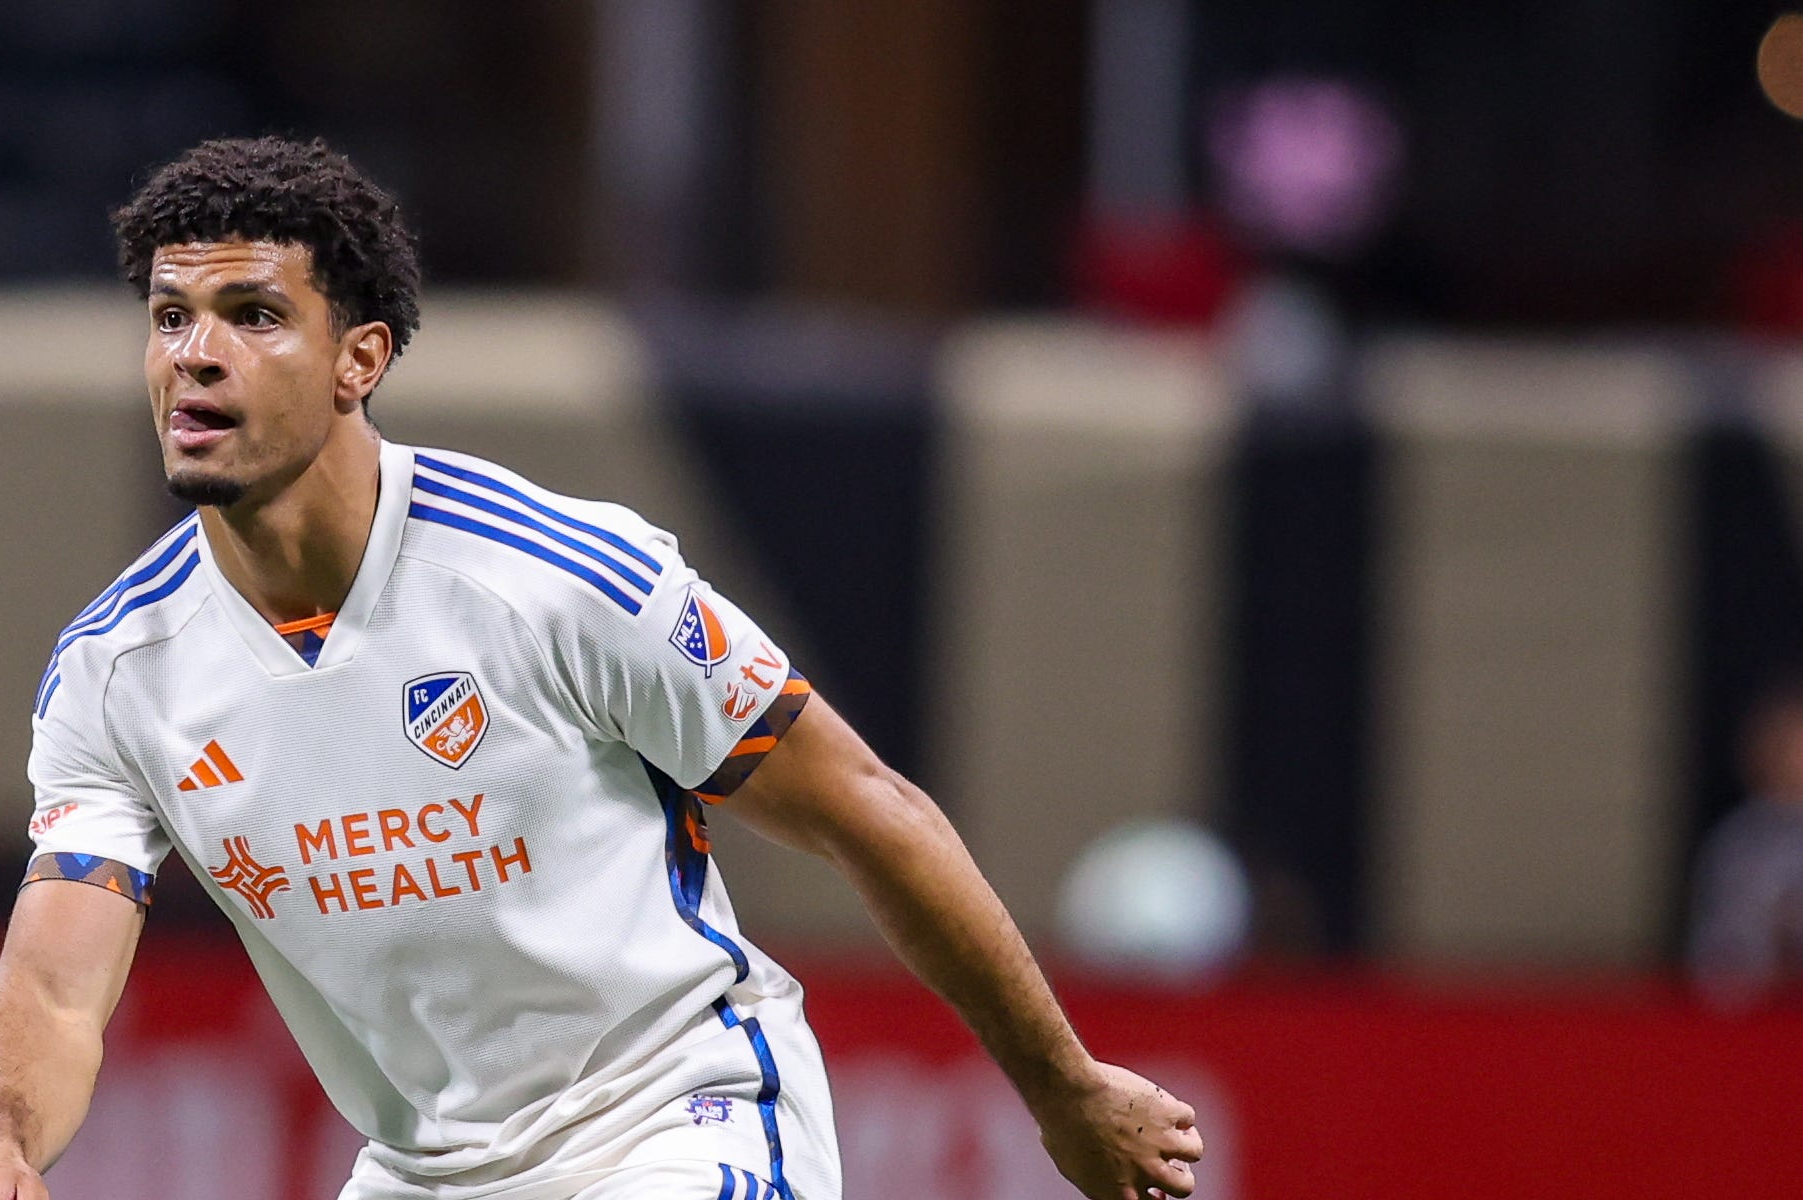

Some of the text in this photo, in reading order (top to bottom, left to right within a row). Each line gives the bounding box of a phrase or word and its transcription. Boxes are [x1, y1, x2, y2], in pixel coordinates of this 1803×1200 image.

[677, 612, 698, 647] MLS
[740, 641, 782, 690] tv
[413, 688, 429, 705] FC
[414, 677, 471, 739] CINCINNATI
[294, 793, 484, 865] MERCY
[308, 836, 532, 914] HEALTH
